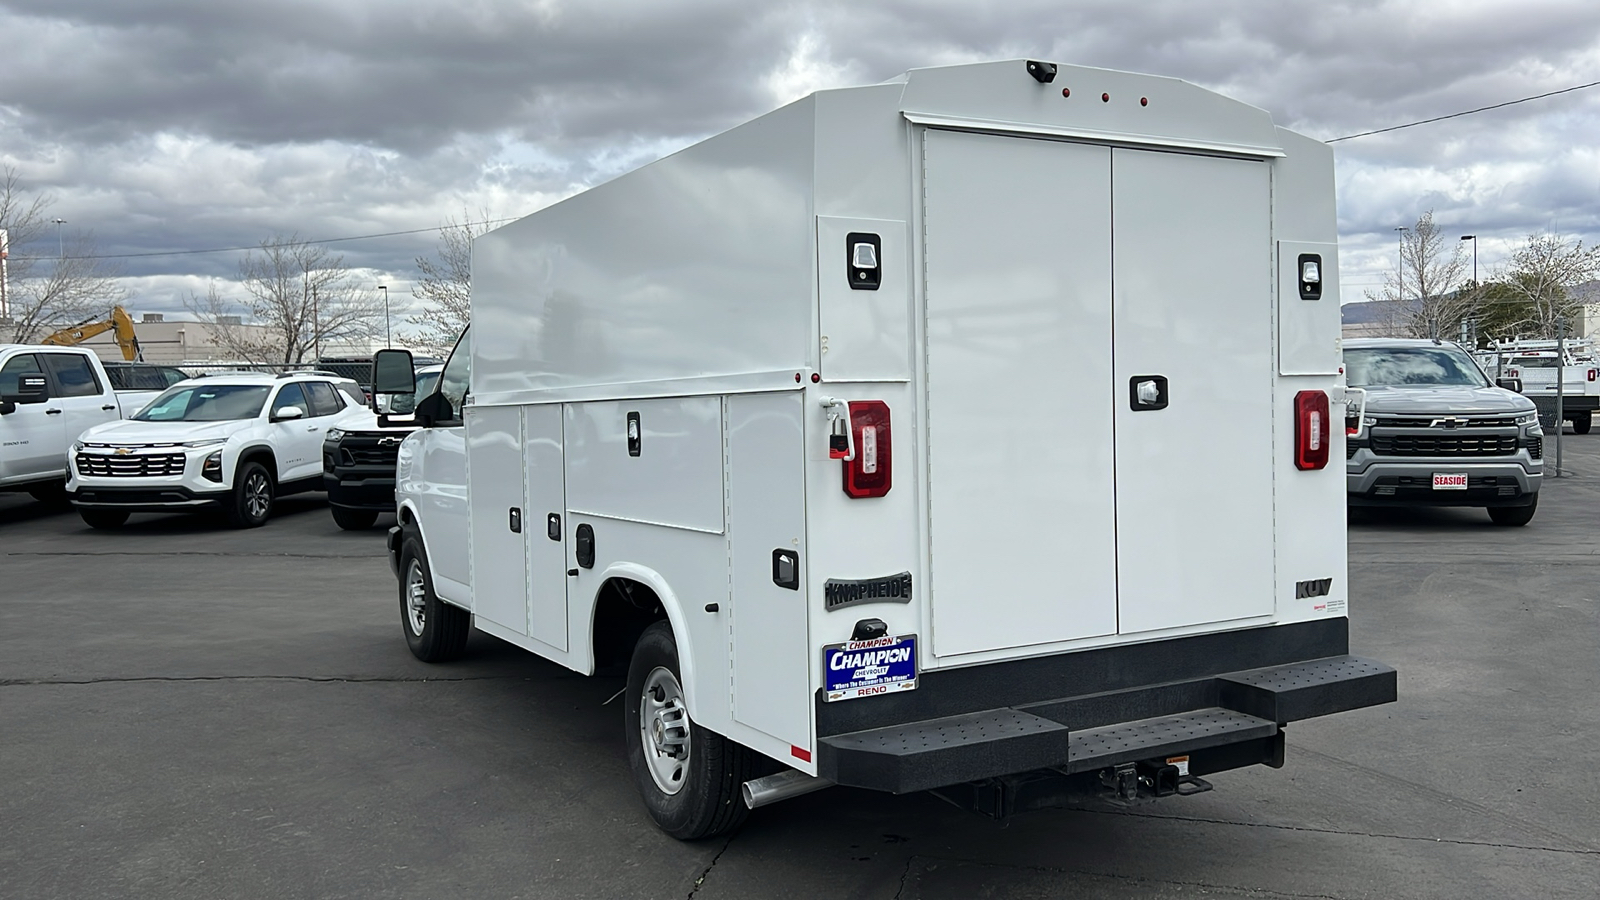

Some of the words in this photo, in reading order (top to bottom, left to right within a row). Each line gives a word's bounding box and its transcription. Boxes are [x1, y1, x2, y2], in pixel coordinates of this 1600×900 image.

[1434, 476, 1466, 485] SEASIDE
[827, 576, 909, 606] KNAPHEIDE
[1295, 577, 1333, 599] KUV
[849, 638, 894, 650] CHAMPION
[830, 647, 912, 671] CHAMPION
[855, 667, 887, 677] CHEVROLET
[857, 685, 887, 697] RENO
